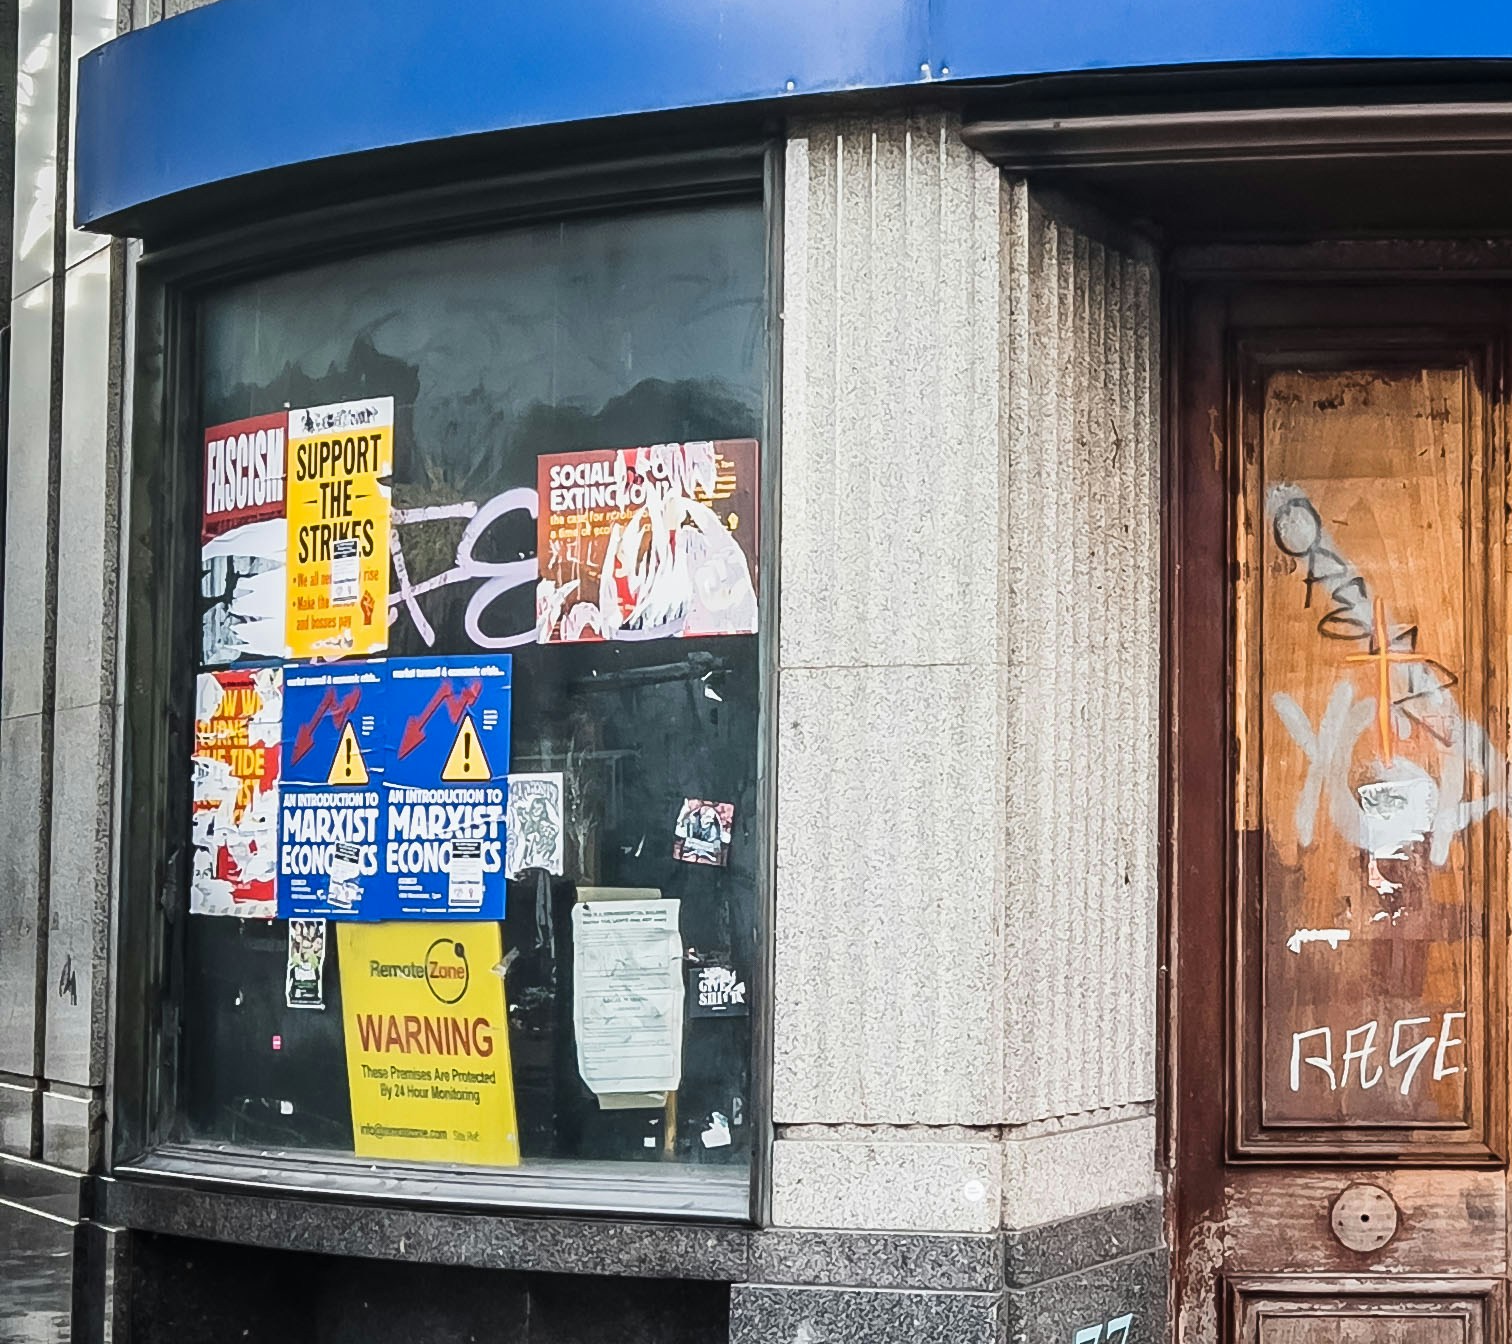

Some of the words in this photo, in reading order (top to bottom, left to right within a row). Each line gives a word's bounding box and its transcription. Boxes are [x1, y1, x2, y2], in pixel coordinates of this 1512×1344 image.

[206, 427, 286, 514] FASCISM
[296, 434, 382, 482] SUPPORT
[319, 479, 354, 520] THE
[230, 748, 266, 776] TIDE
[283, 793, 296, 807] AN
[297, 792, 361, 807] INTRODUCTION
[361, 792, 379, 806] TO
[388, 790, 403, 804] AN
[404, 789, 484, 804] INTRODUCTION
[486, 789, 503, 804] TO
[282, 808, 379, 843] MARXIST
[387, 805, 502, 840] MARXIST
[281, 843, 378, 875] ECONOCS
[386, 841, 501, 874] ECONOCS
[356, 1013, 494, 1057] WARNING
[361, 1064, 389, 1079] These
[390, 1065, 432, 1080] Premises
[434, 1067, 450, 1082] Are
[452, 1068, 496, 1085] Protected
[380, 1083, 392, 1100] By
[394, 1083, 405, 1097] 24
[407, 1084, 429, 1099] Hour
[431, 1085, 481, 1106] Monitoring
